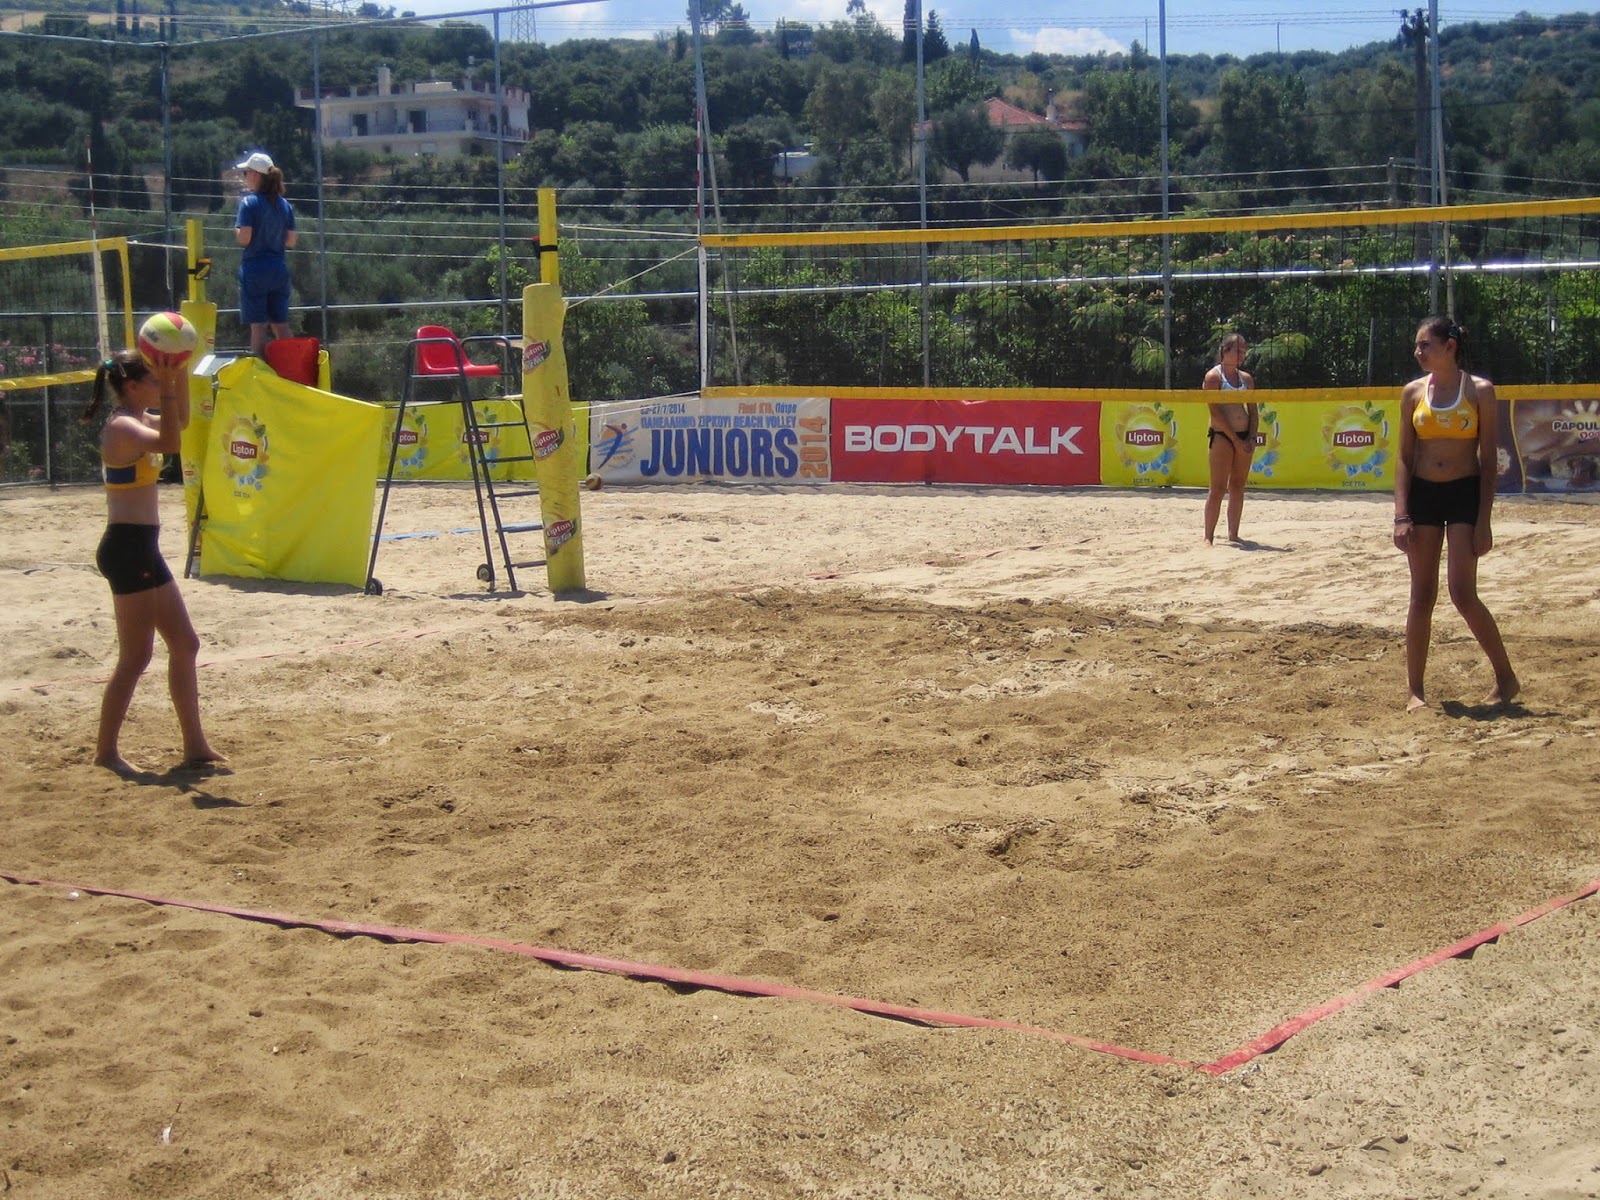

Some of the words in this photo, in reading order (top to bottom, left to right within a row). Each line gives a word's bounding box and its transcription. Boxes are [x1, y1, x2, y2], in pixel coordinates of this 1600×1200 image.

[733, 415, 763, 428] BEACH
[764, 415, 797, 428] VOLLEY
[398, 433, 417, 443] pton
[844, 424, 1084, 455] BODYTALK
[1128, 432, 1161, 444] Lipton
[1336, 434, 1371, 446] Lipton
[232, 443, 255, 456] Lipton
[640, 428, 798, 478] JUNIORS
[799, 417, 829, 479] 2014
[546, 522, 571, 537] Lipton
